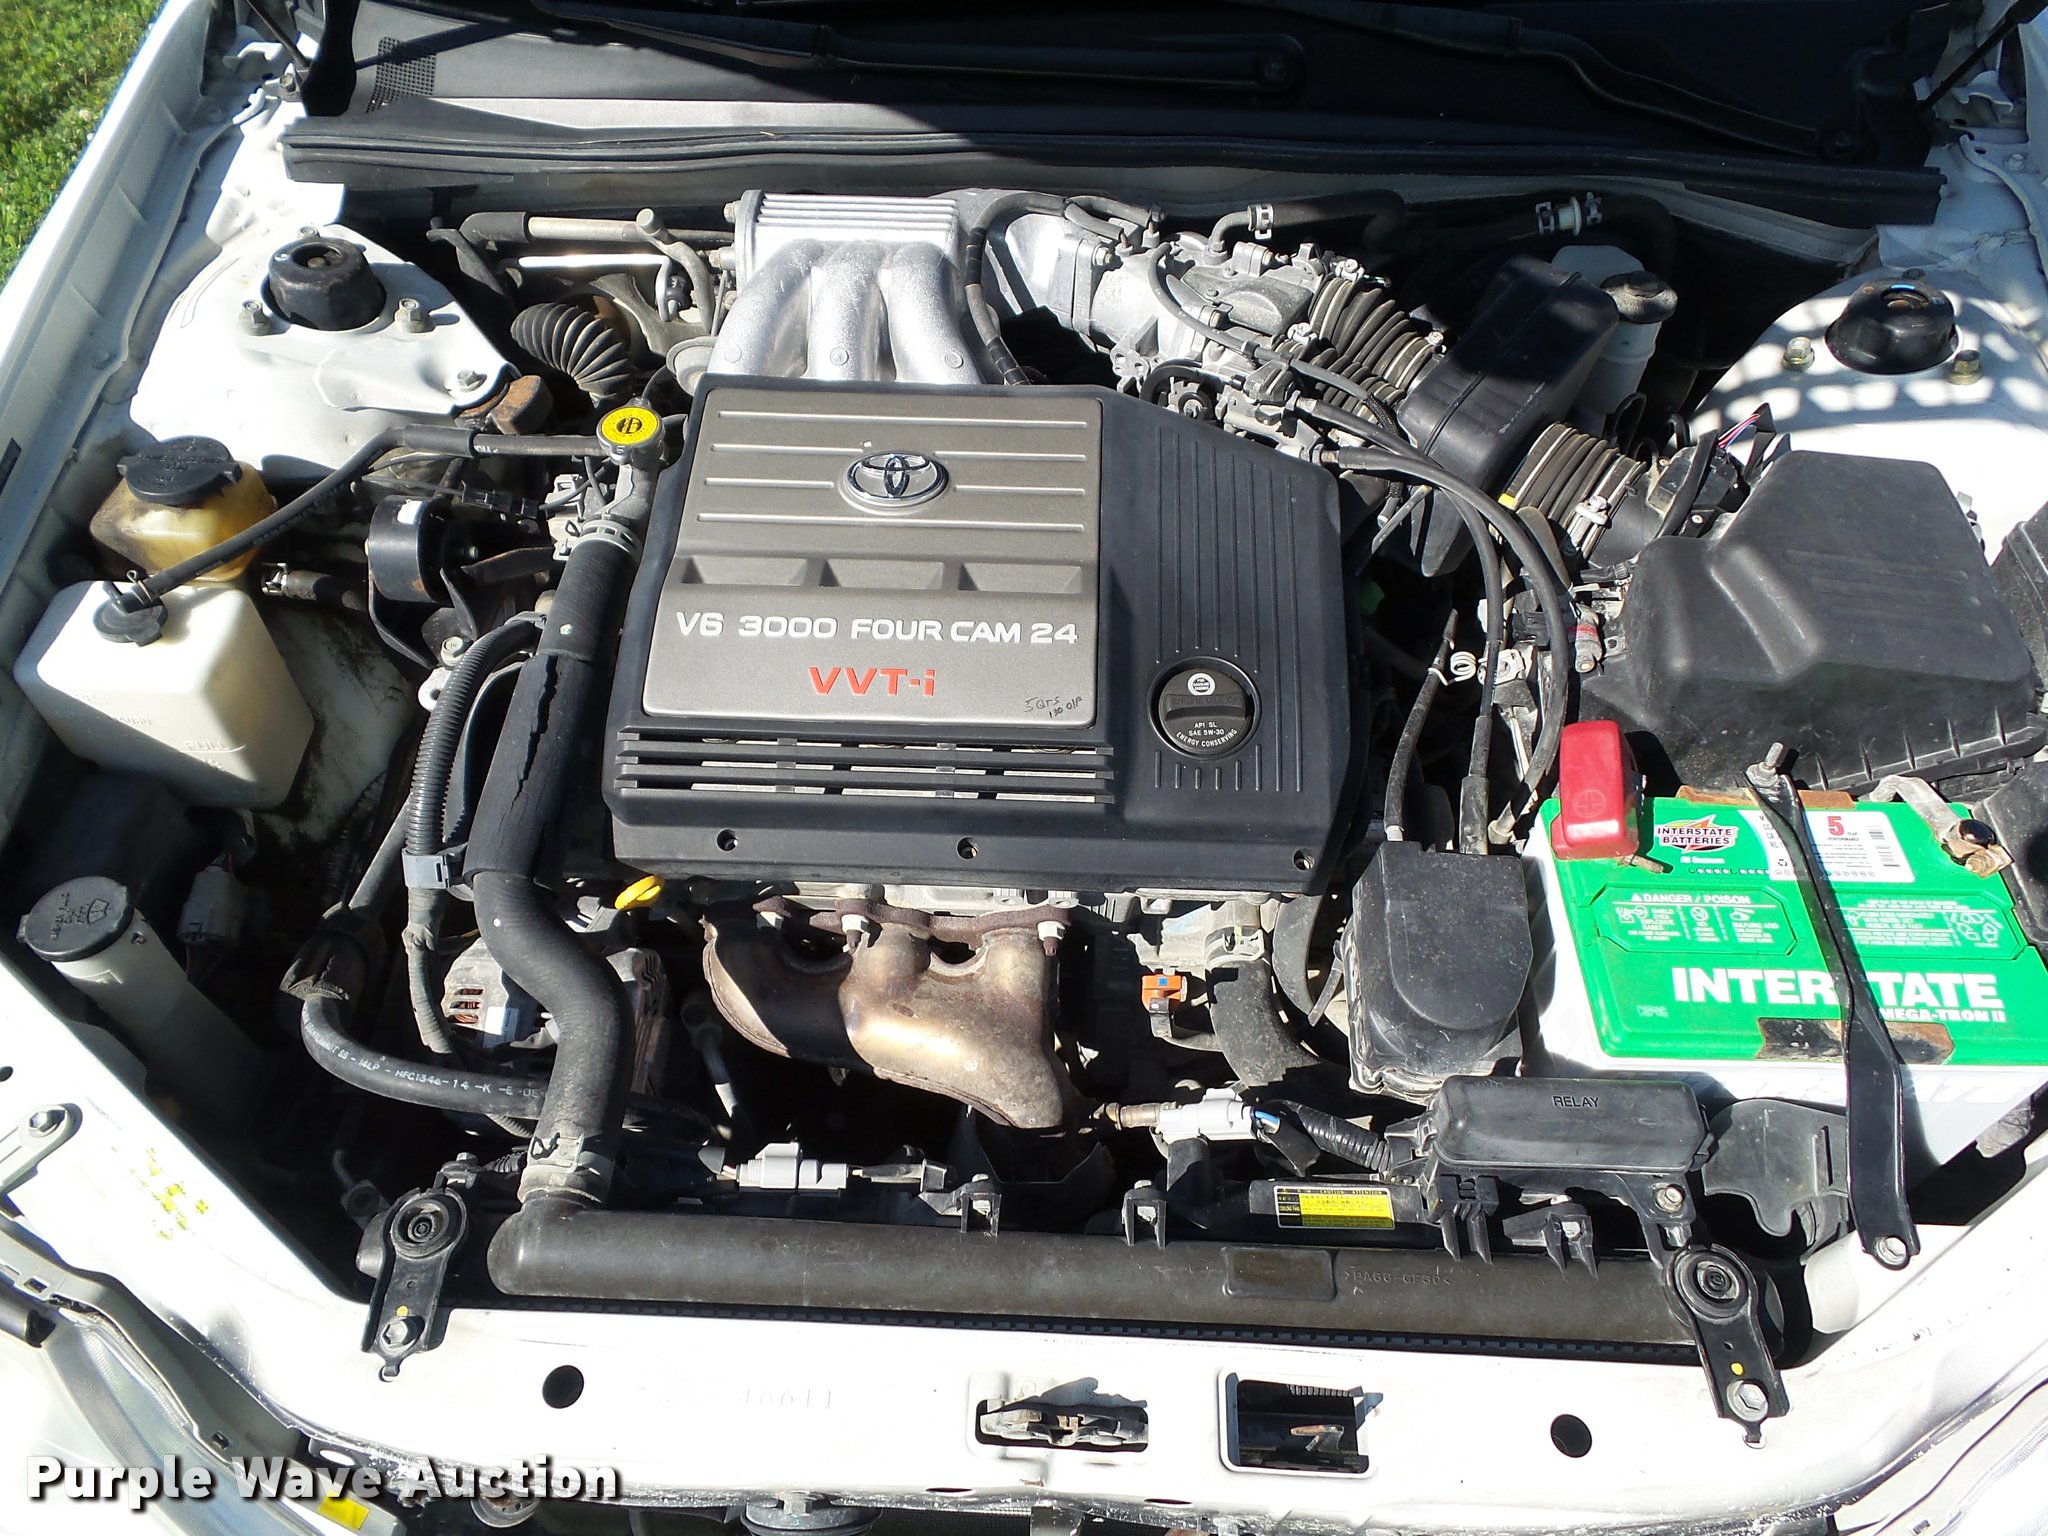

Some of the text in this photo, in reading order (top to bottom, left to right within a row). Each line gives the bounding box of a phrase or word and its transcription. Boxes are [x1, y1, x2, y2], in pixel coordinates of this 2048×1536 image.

[676, 612, 1078, 645] V6 3000 FOUR CAM 24
[808, 665, 936, 697] VVT-i
[1176, 728, 1238, 747] ENERGY CONSERVING
[1203, 728, 1225, 736] 5W-30
[1656, 826, 1733, 837] INTERSTATE
[1827, 815, 1845, 836] 5
[1661, 836, 1731, 845] BATTERIES
[1642, 893, 1693, 903] DANGER
[1703, 895, 1751, 905] POISON
[1671, 967, 2005, 1009] INTERTATE
[1552, 1095, 1599, 1108] RELAY
